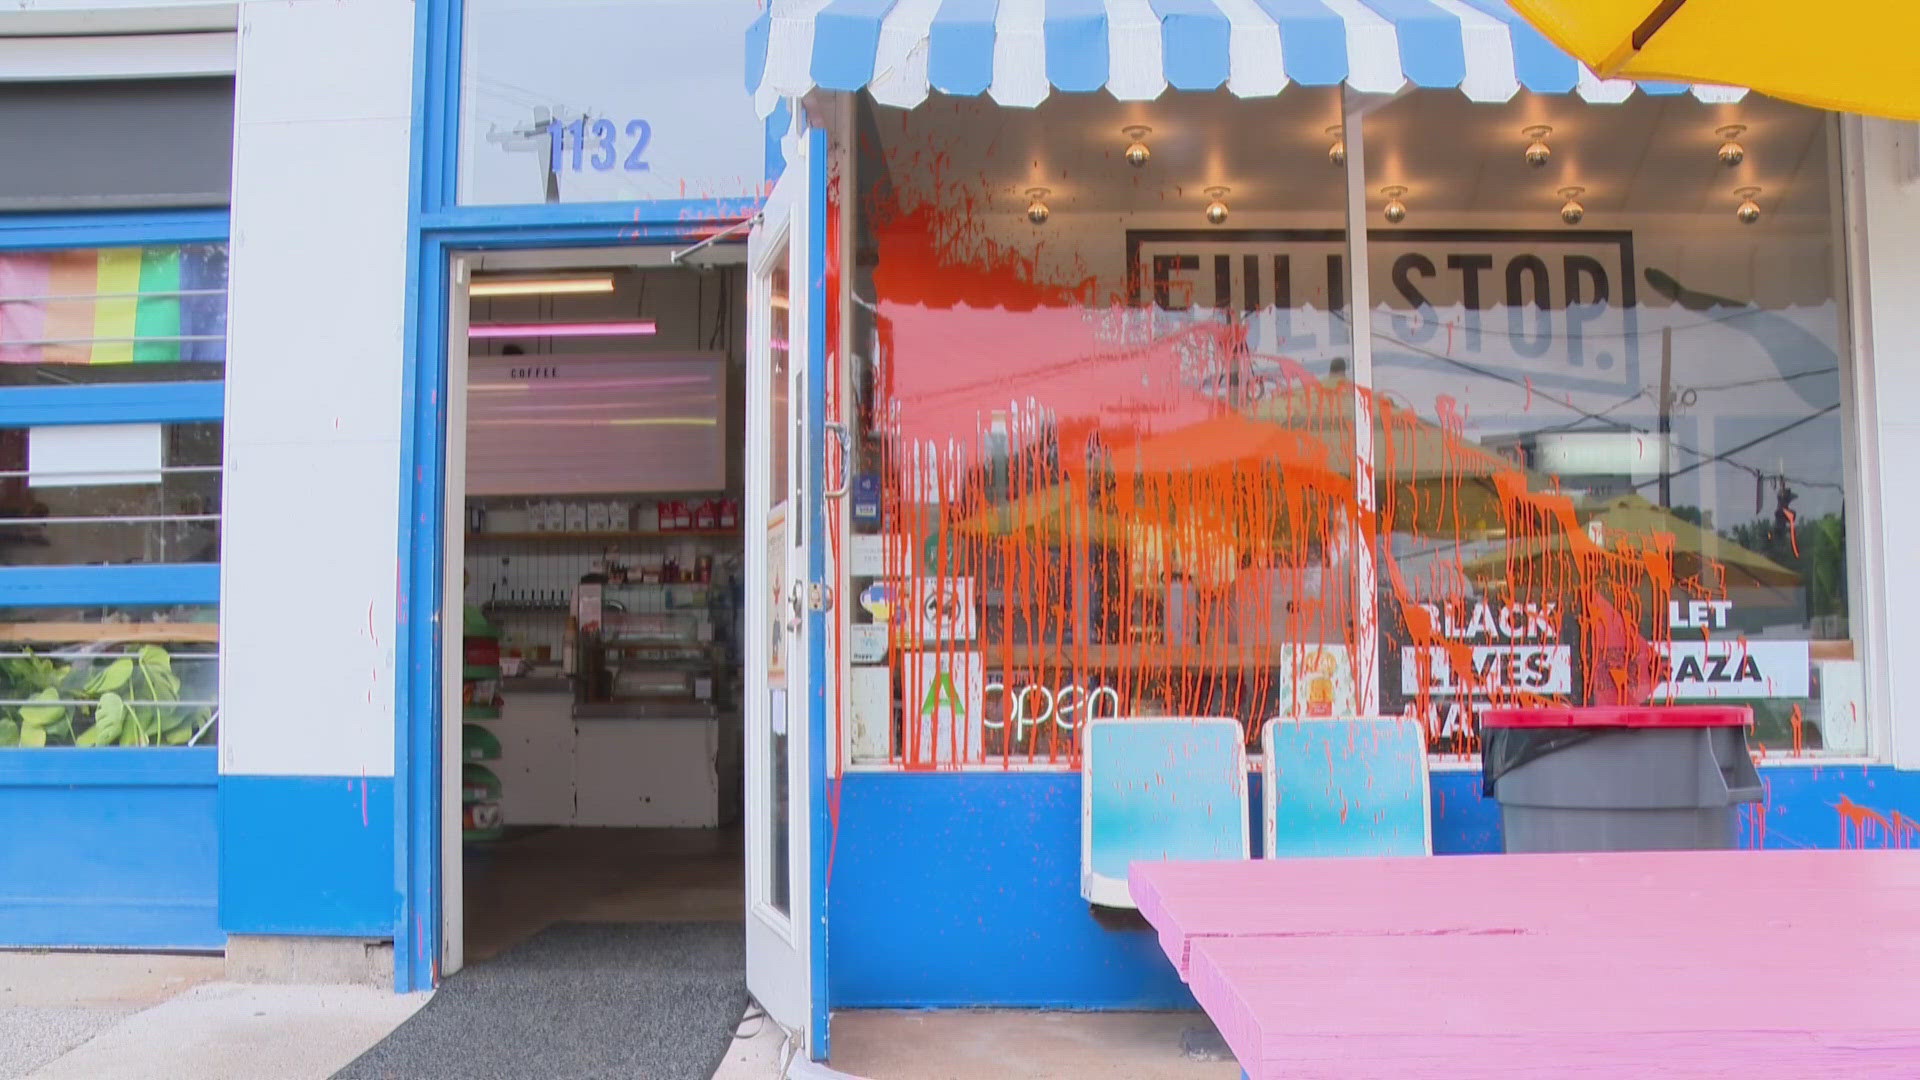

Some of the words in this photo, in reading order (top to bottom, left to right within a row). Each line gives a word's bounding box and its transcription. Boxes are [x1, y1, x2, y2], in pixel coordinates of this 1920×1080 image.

[547, 118, 652, 171] 1132
[511, 367, 559, 379] COFFEE
[1669, 600, 1732, 628] LET
[983, 683, 1118, 742] open
